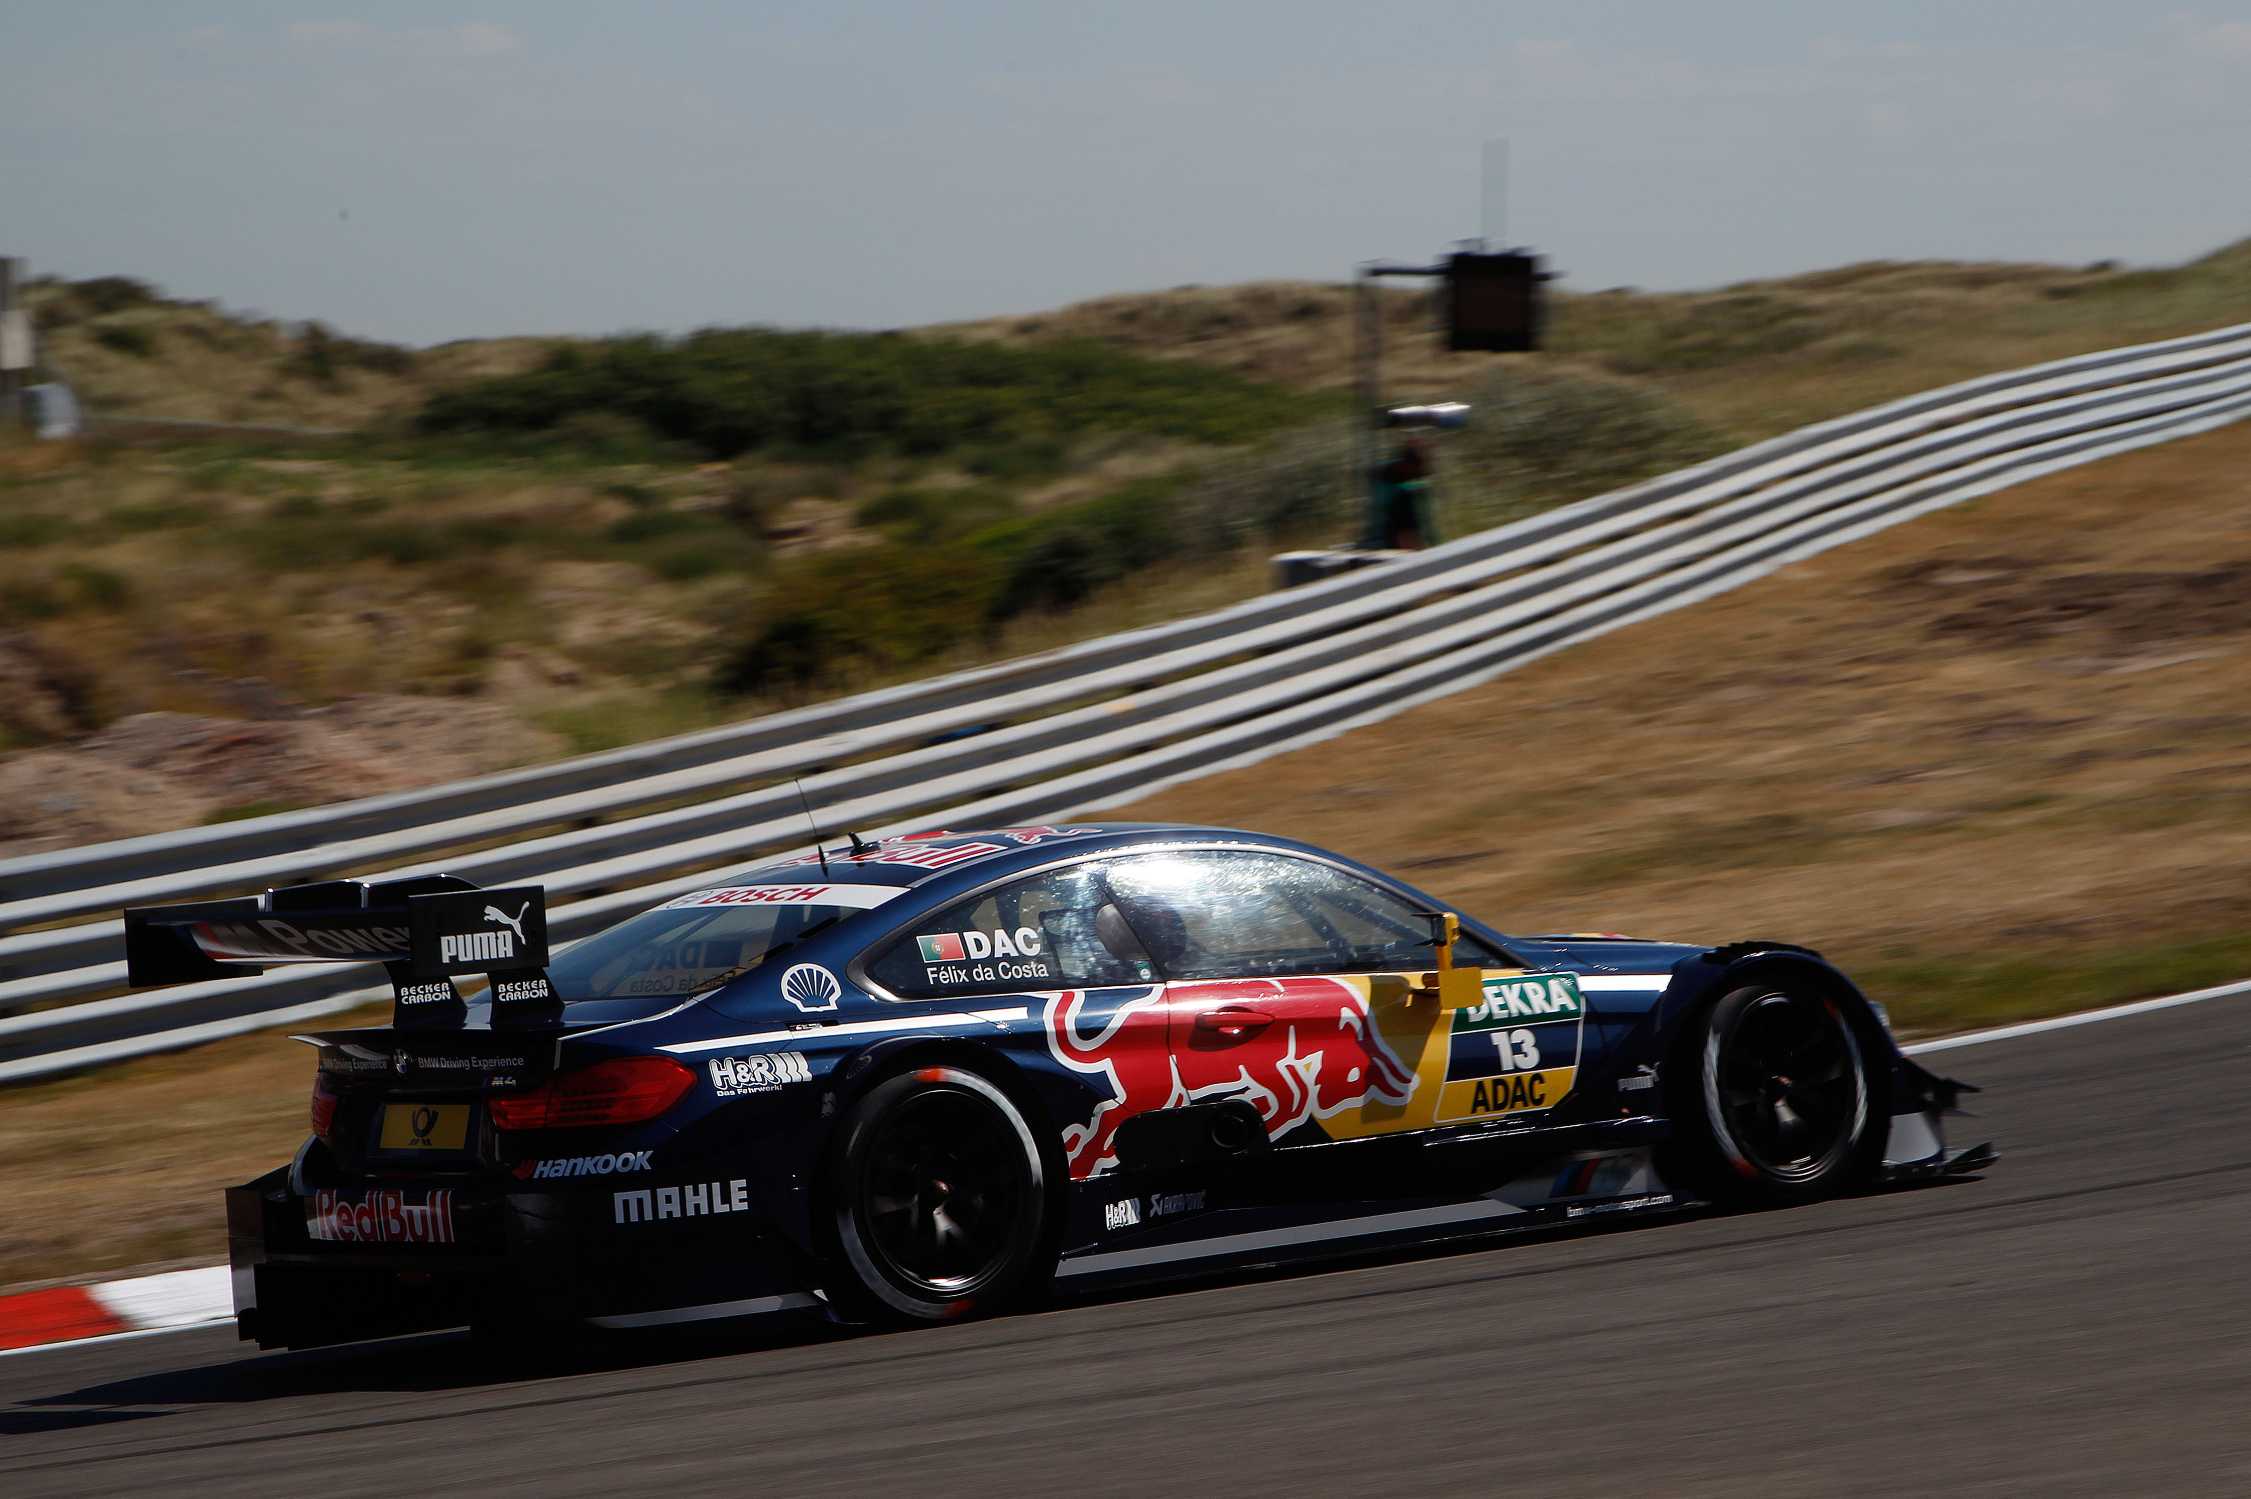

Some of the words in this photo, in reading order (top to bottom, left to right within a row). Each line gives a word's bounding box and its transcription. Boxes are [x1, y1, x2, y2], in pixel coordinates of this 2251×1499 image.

[698, 886, 829, 905] BOSCH
[440, 930, 514, 964] PUMA
[963, 926, 1041, 960] DAC
[497, 978, 548, 993] BECKER
[926, 964, 969, 985] Félix
[972, 963, 995, 983] da
[997, 960, 1050, 980] Costa
[400, 981, 450, 996] BECKER
[401, 990, 451, 1005] CARBON
[498, 988, 549, 1002] CARBON
[418, 1056, 440, 1070] BMW
[440, 1056, 470, 1071] Driving
[471, 1055, 525, 1071] Experience
[1490, 1028, 1541, 1072] 13
[709, 1055, 781, 1091] H&R
[1471, 1072, 1546, 1114] ADAC
[613, 1178, 750, 1224] MAHLE
[315, 1188, 381, 1242] Red
[379, 1188, 457, 1244] Bull
